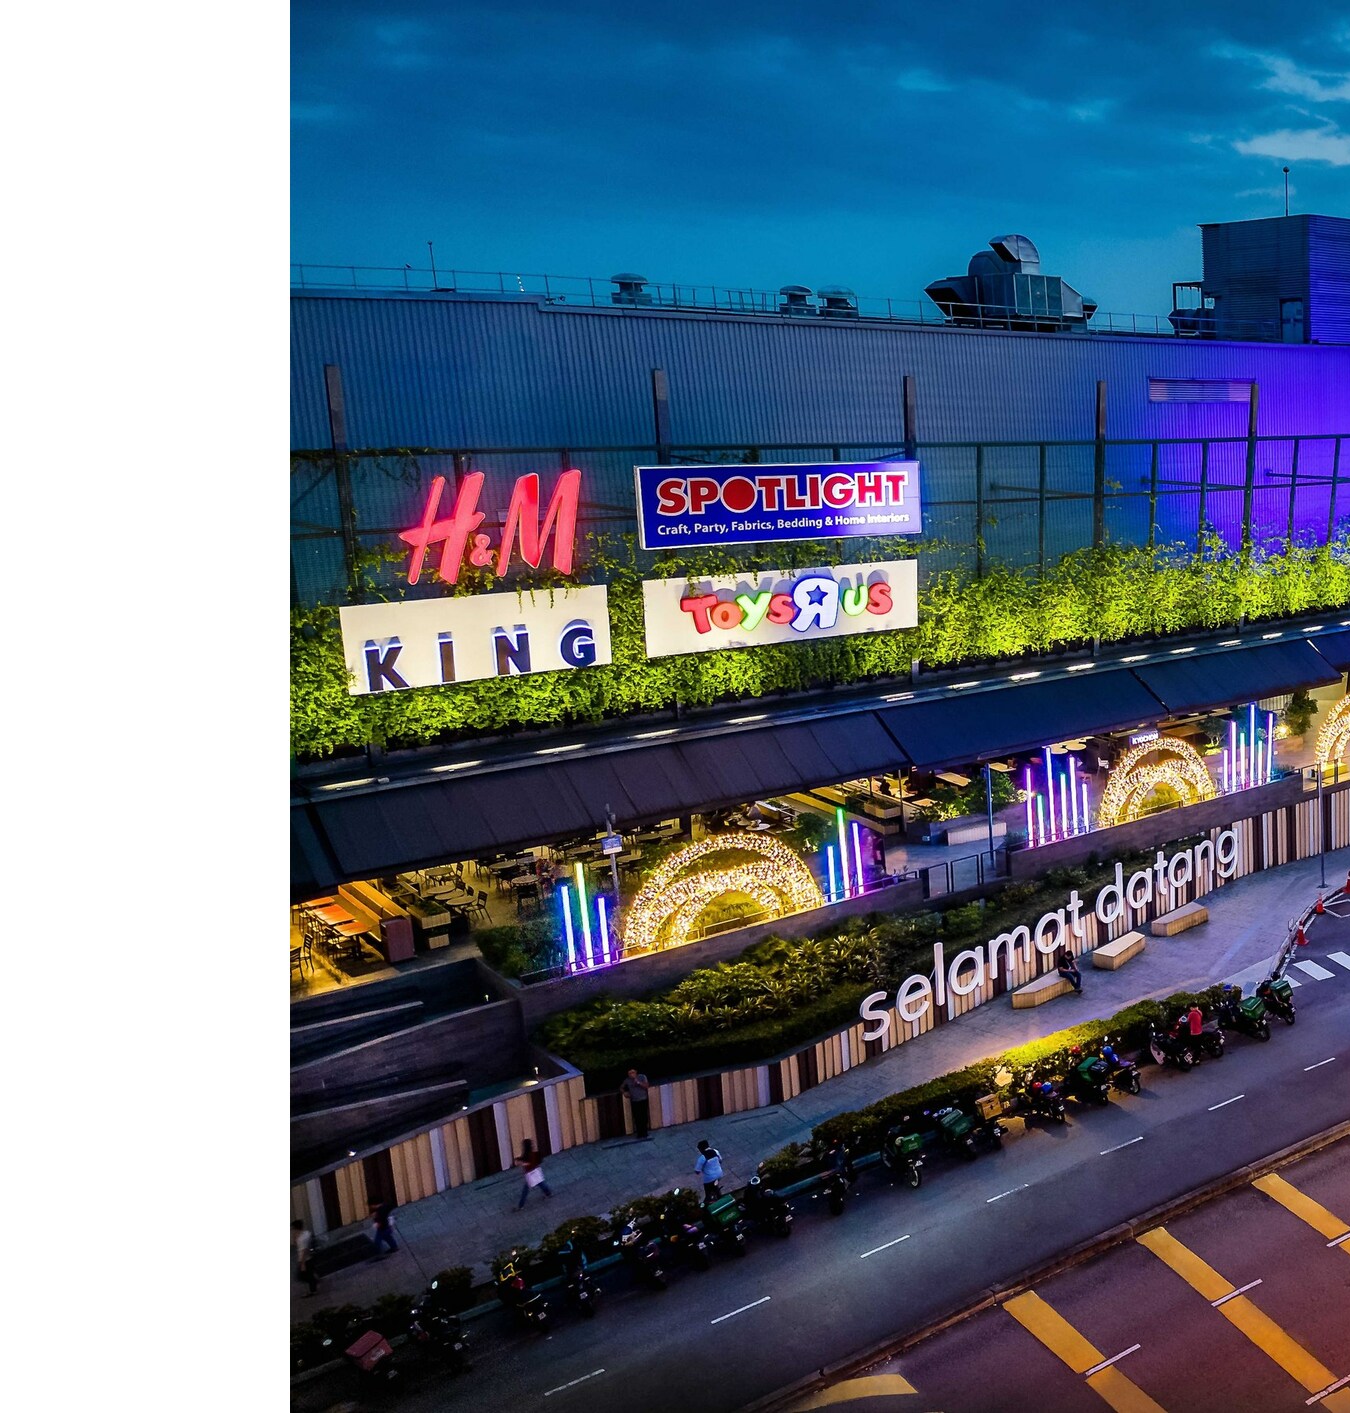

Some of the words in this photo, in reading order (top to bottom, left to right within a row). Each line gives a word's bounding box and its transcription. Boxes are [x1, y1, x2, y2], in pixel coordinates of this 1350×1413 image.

[656, 471, 909, 516] SPOTLIGHT
[657, 523, 692, 536] Craft,
[694, 522, 729, 534] Party,
[731, 519, 775, 531] Fabrics,
[777, 517, 823, 529] Bedding
[825, 516, 833, 526] &
[835, 514, 866, 525] Home
[866, 512, 910, 523] Interiors
[399, 469, 582, 586] H&M
[363, 625, 598, 692] KING
[860, 889, 1084, 1041] selamat
[1096, 828, 1238, 924] datang
